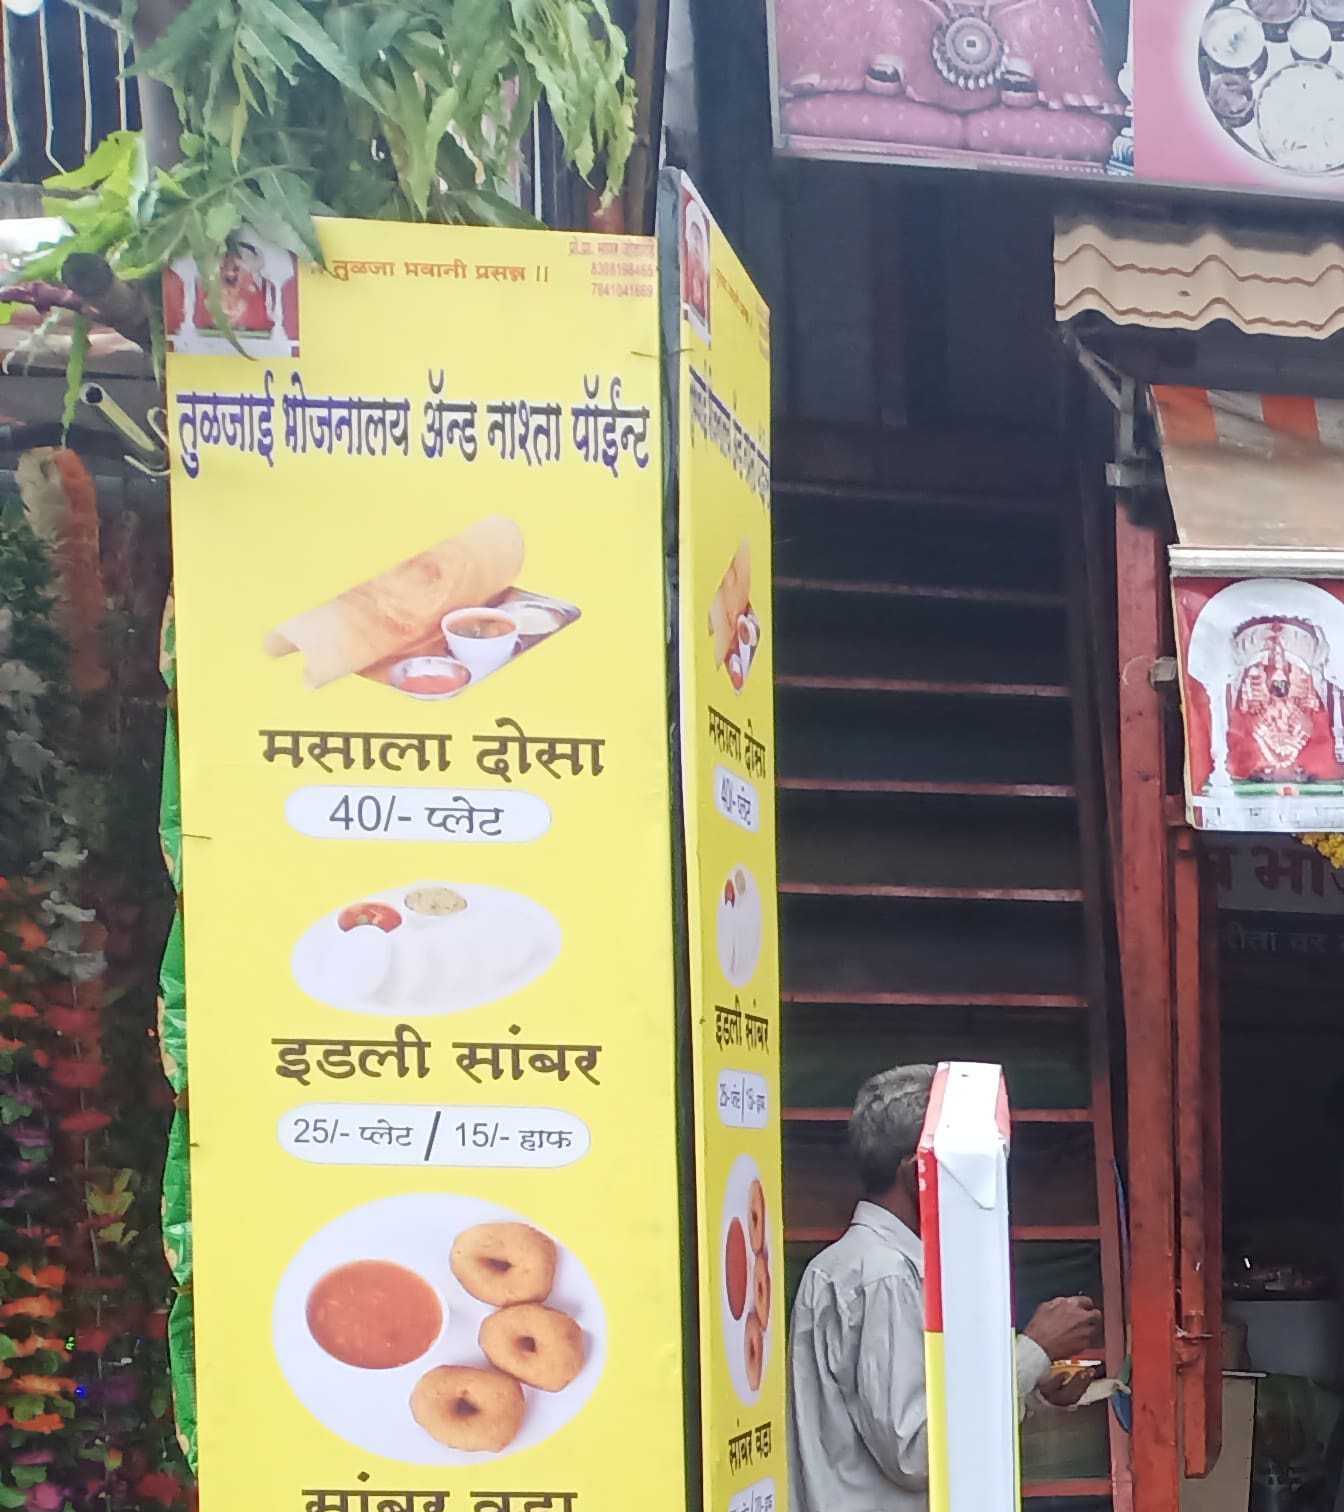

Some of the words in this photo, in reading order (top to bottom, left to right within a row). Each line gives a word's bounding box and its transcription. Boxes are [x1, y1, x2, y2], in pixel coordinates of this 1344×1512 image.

[176, 369, 275, 479] तुळजाई
[283, 371, 410, 457] भोजनालय
[487, 400, 562, 467] नाश्ता
[258, 728, 453, 774] मसाला
[473, 717, 606, 783] दोसा
[328, 794, 412, 834] 40/-
[424, 796, 505, 837] प्लेट
[271, 1022, 432, 1081] इडली
[452, 1023, 603, 1086] सांबर
[292, 1118, 350, 1146] 25/-
[359, 1116, 414, 1148] प्लेट
[454, 1121, 510, 1149] 15/-
[519, 1126, 573, 1152] हाफ
